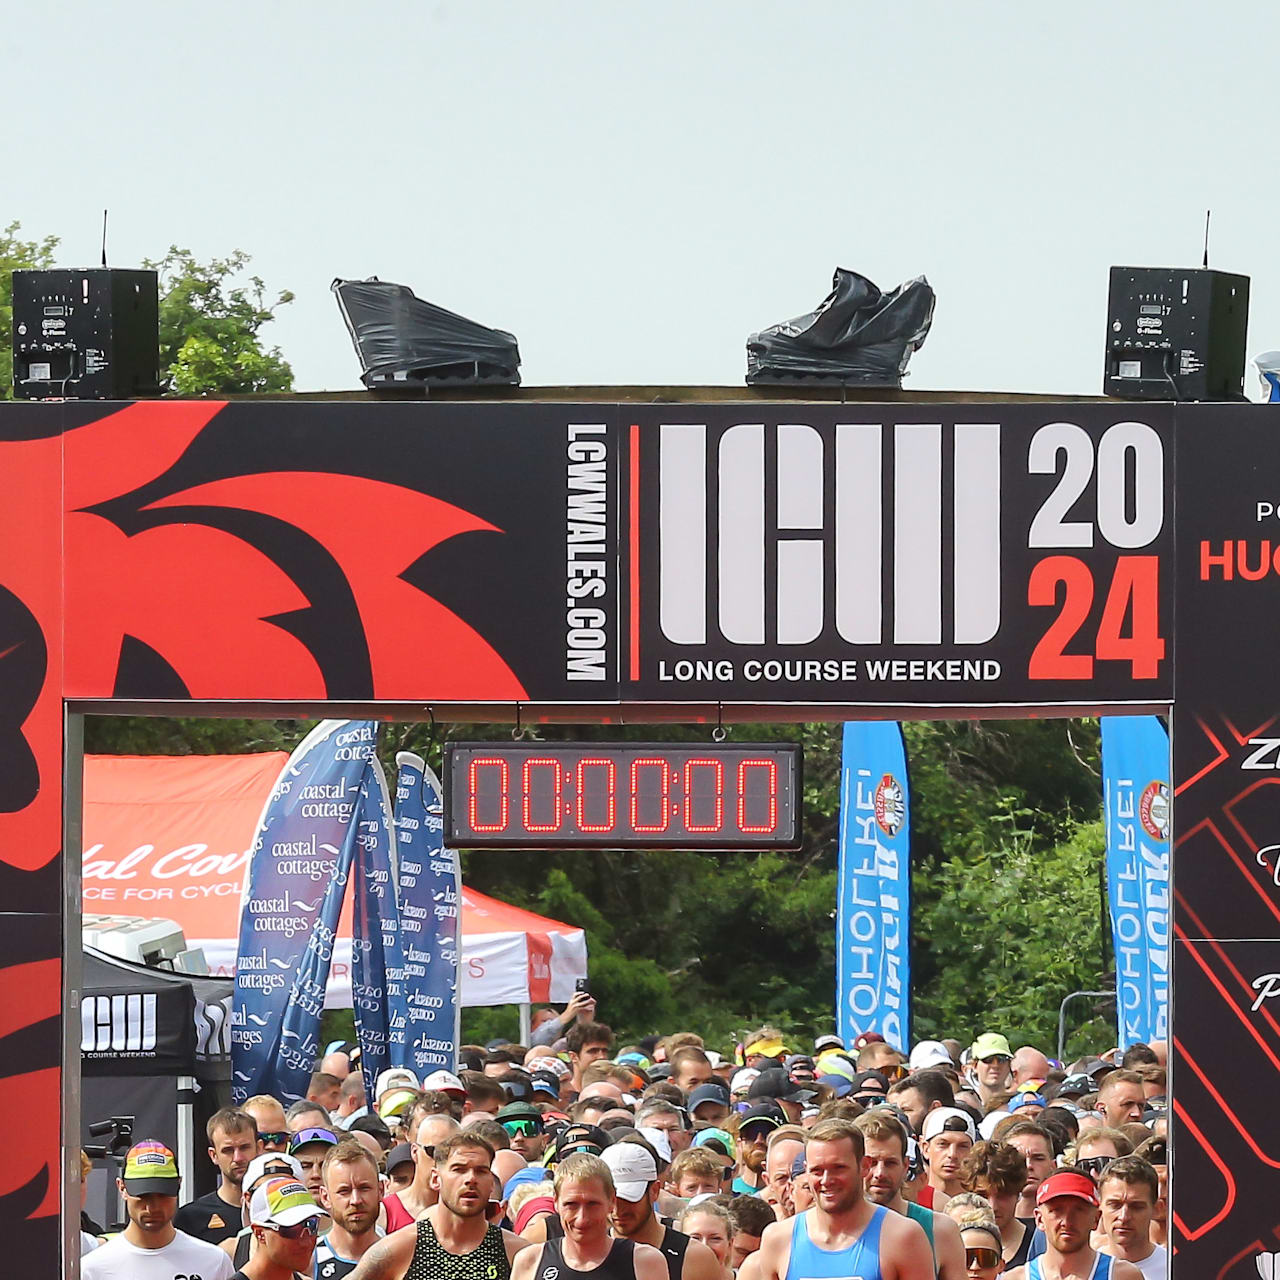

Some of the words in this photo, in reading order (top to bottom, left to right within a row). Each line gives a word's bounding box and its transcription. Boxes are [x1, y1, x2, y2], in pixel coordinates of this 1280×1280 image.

[1028, 421, 1165, 549] 20
[567, 423, 607, 681] LCWWALES.COM
[1027, 555, 1165, 680] 24
[658, 659, 734, 682] LONG
[743, 659, 857, 682] COURSE
[866, 659, 1001, 682] WEEKEND
[272, 834, 317, 858] coastal
[277, 860, 336, 881] cottages
[123, 886, 174, 901] FOR
[250, 890, 290, 914] coastal
[254, 916, 309, 938] cottages
